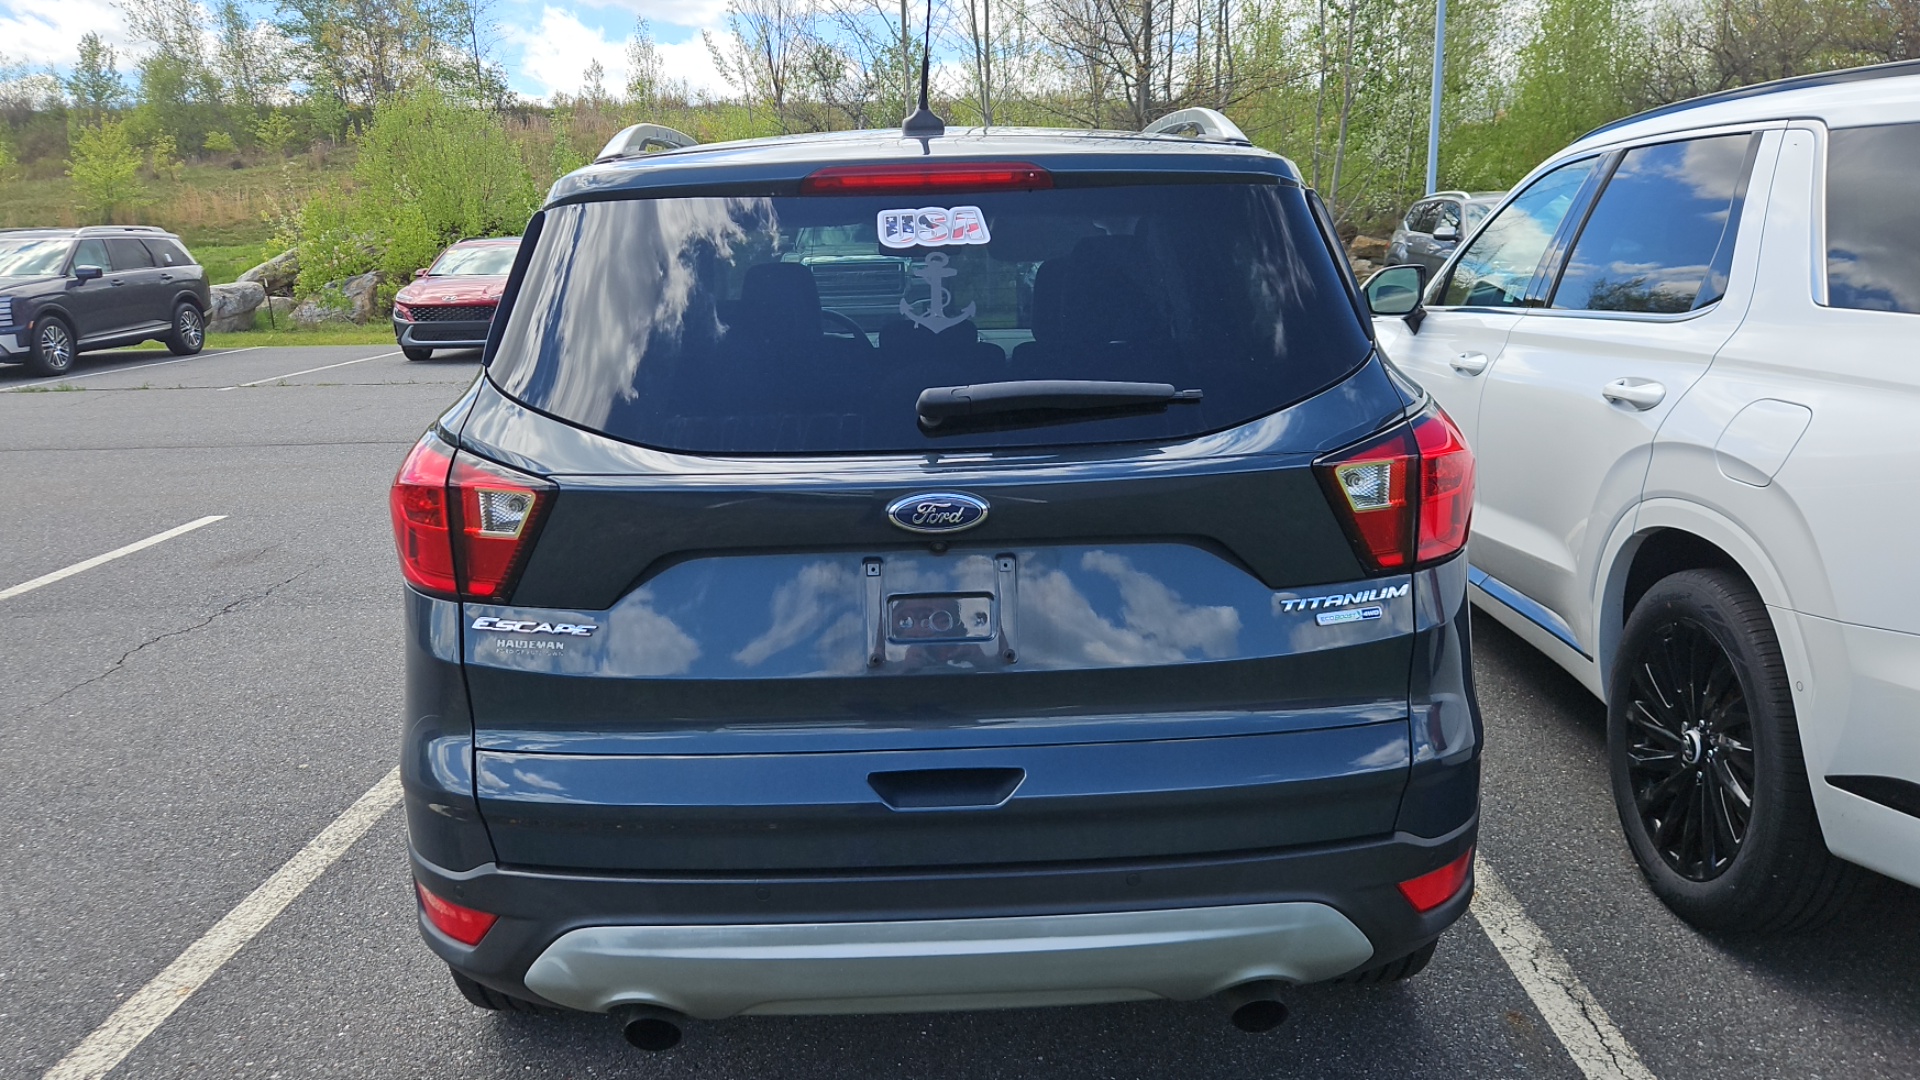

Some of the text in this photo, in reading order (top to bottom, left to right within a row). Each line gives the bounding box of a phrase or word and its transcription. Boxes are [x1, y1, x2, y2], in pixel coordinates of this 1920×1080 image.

[882, 209, 985, 244] USA
[912, 502, 964, 525] Ford
[1280, 583, 1410, 612] TITANIUM
[471, 616, 598, 637] ESCAPE
